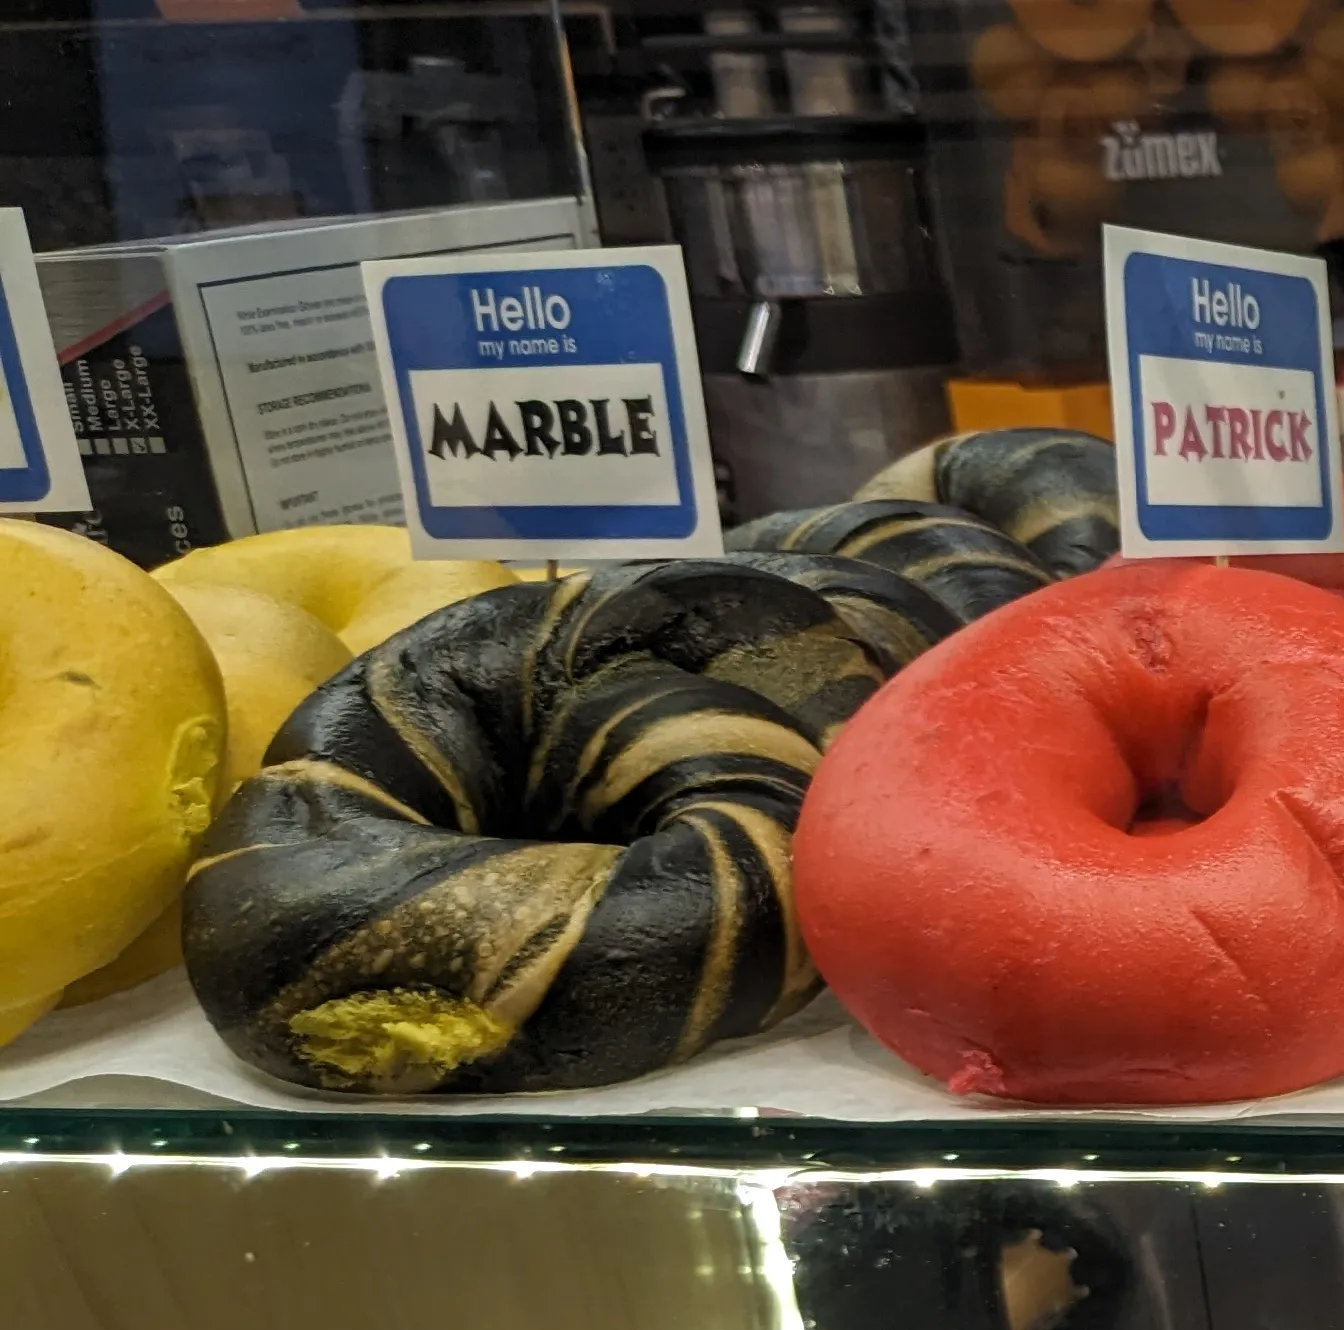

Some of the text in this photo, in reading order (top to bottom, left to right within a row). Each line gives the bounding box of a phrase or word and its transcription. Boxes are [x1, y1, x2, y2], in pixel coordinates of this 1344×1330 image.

[471, 286, 572, 333] Hello
[1192, 278, 1261, 331] Hello
[478, 333, 578, 360] my name is
[1194, 330, 1264, 356] my name is
[77, 359, 104, 432] Medium
[100, 379, 121, 432] Large
[113, 358, 140, 431] X-Large
[130, 345, 161, 431] XX-Large
[428, 394, 660, 462] MARBLE
[1150, 401, 1314, 465] PATRICK
